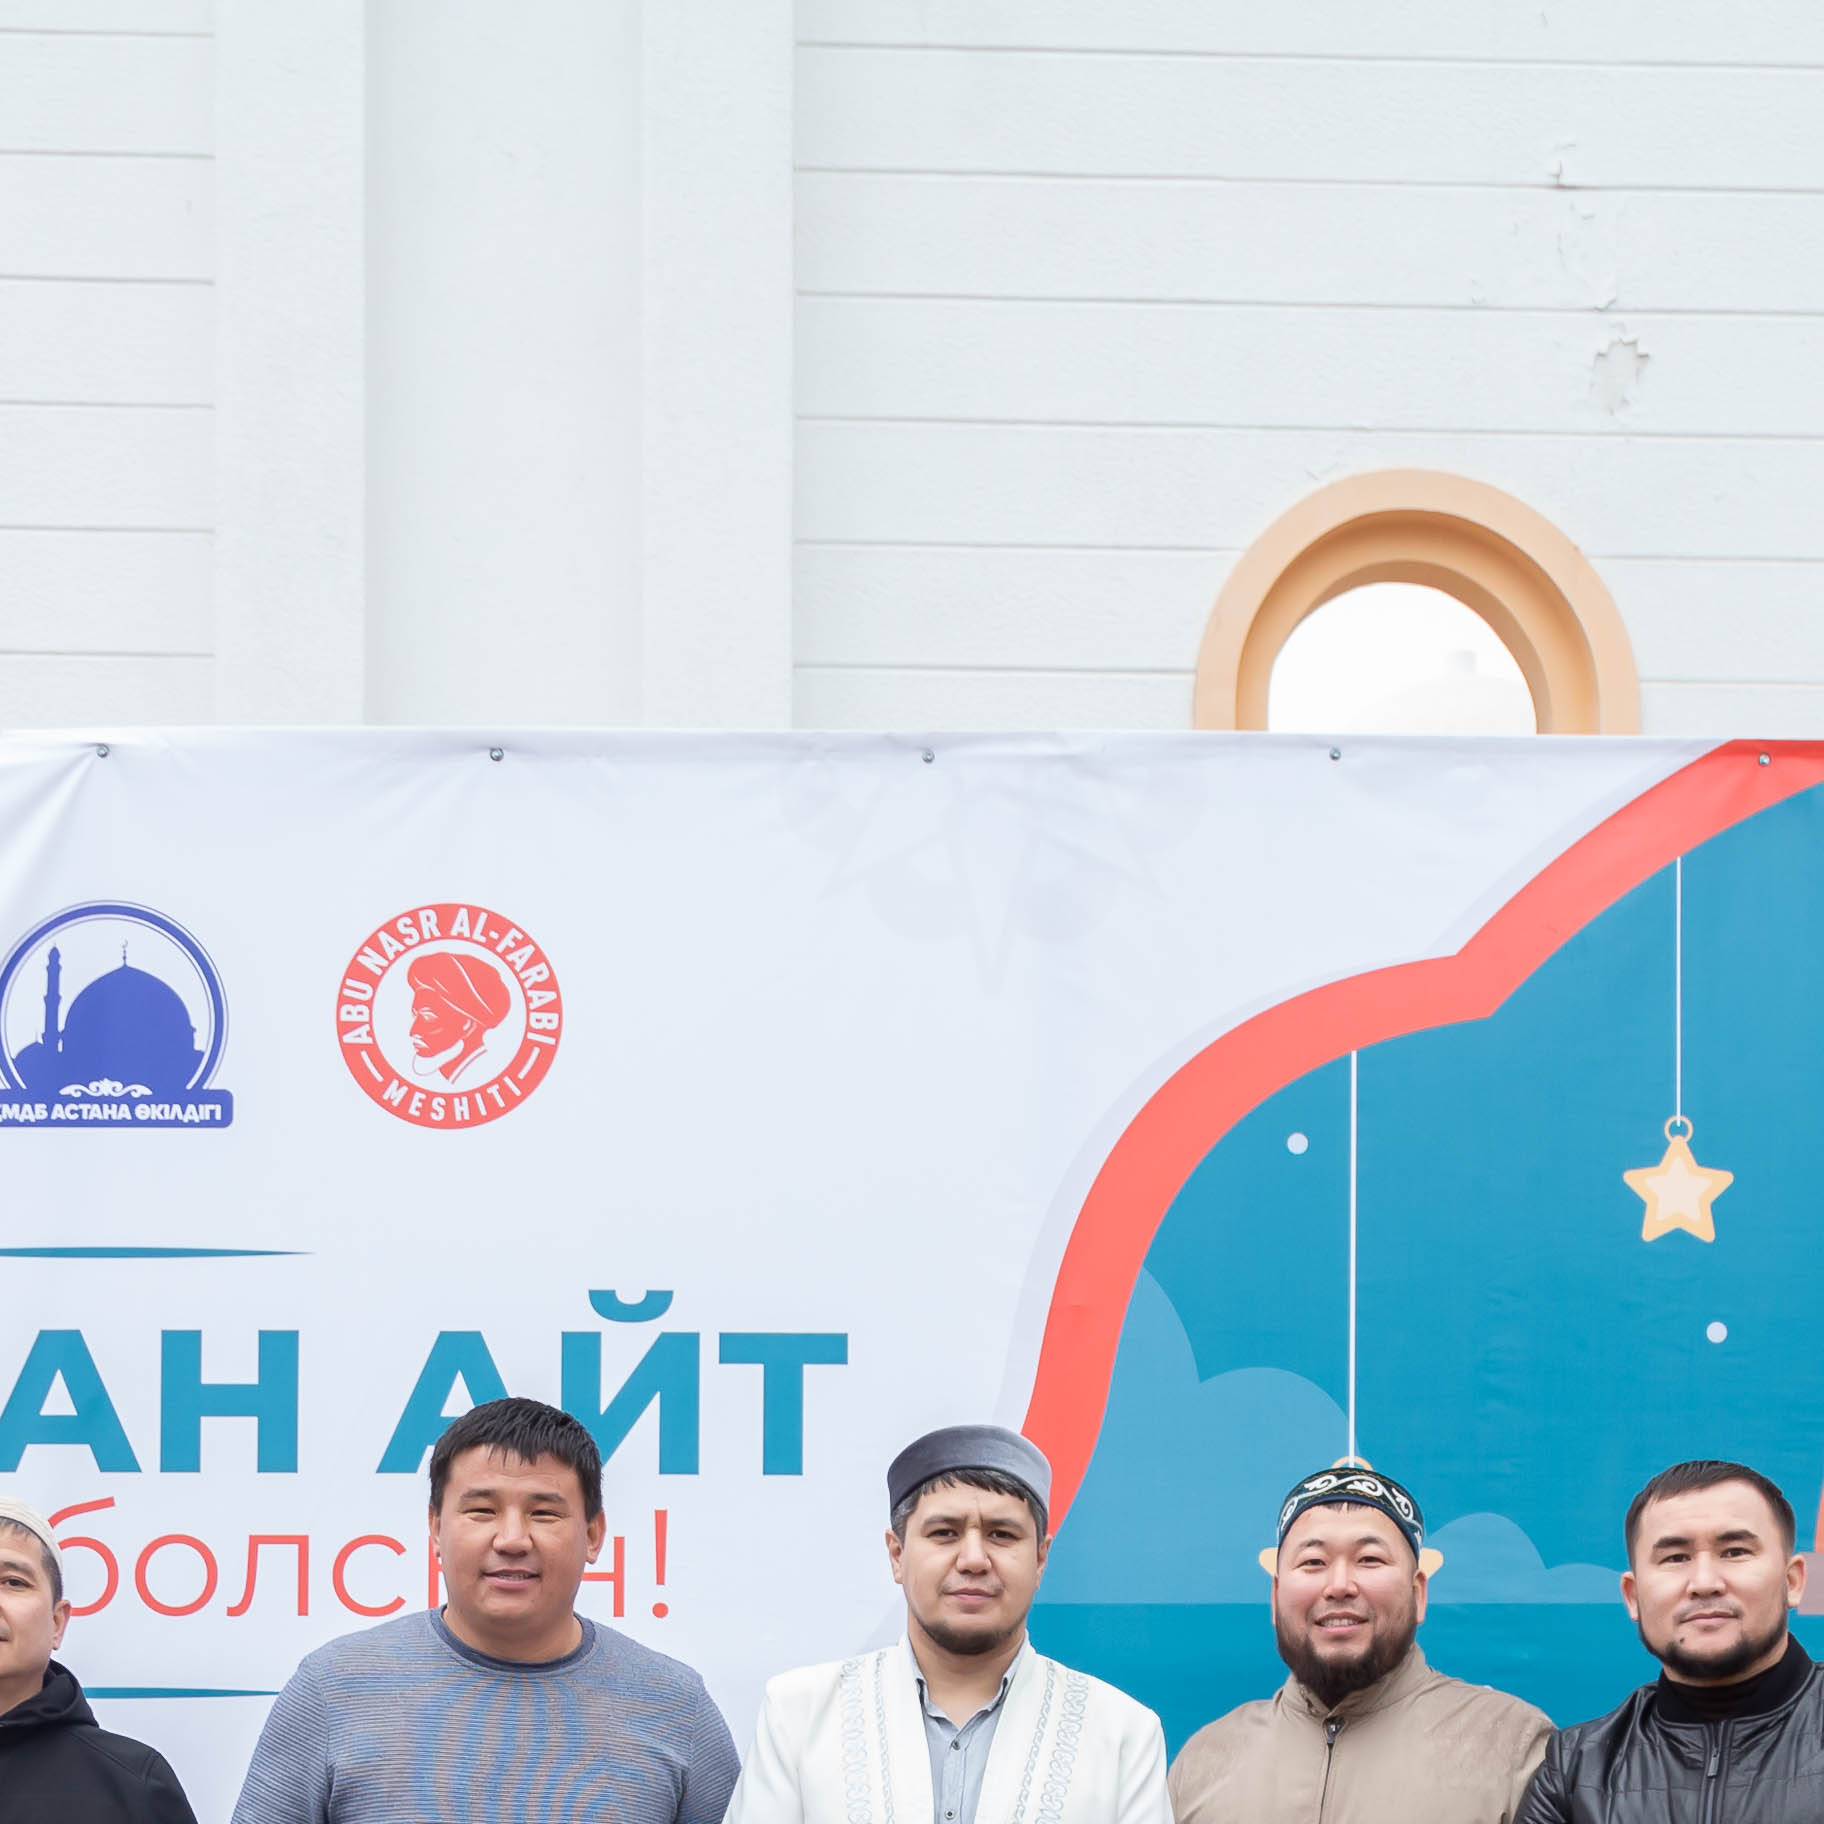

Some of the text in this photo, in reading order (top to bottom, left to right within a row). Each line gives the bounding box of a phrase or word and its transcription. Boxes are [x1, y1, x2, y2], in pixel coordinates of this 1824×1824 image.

[339, 906, 560, 1046] ABU NASR AL-FARABI
[50, 1102, 133, 1121] АСТАНА
[134, 1102, 223, 1124] ӨКІЛДІГІ
[381, 1075, 522, 1122] MESHITI
[375, 1289, 849, 1476] АЙТ
[47, 1495, 670, 1620] болсн!
